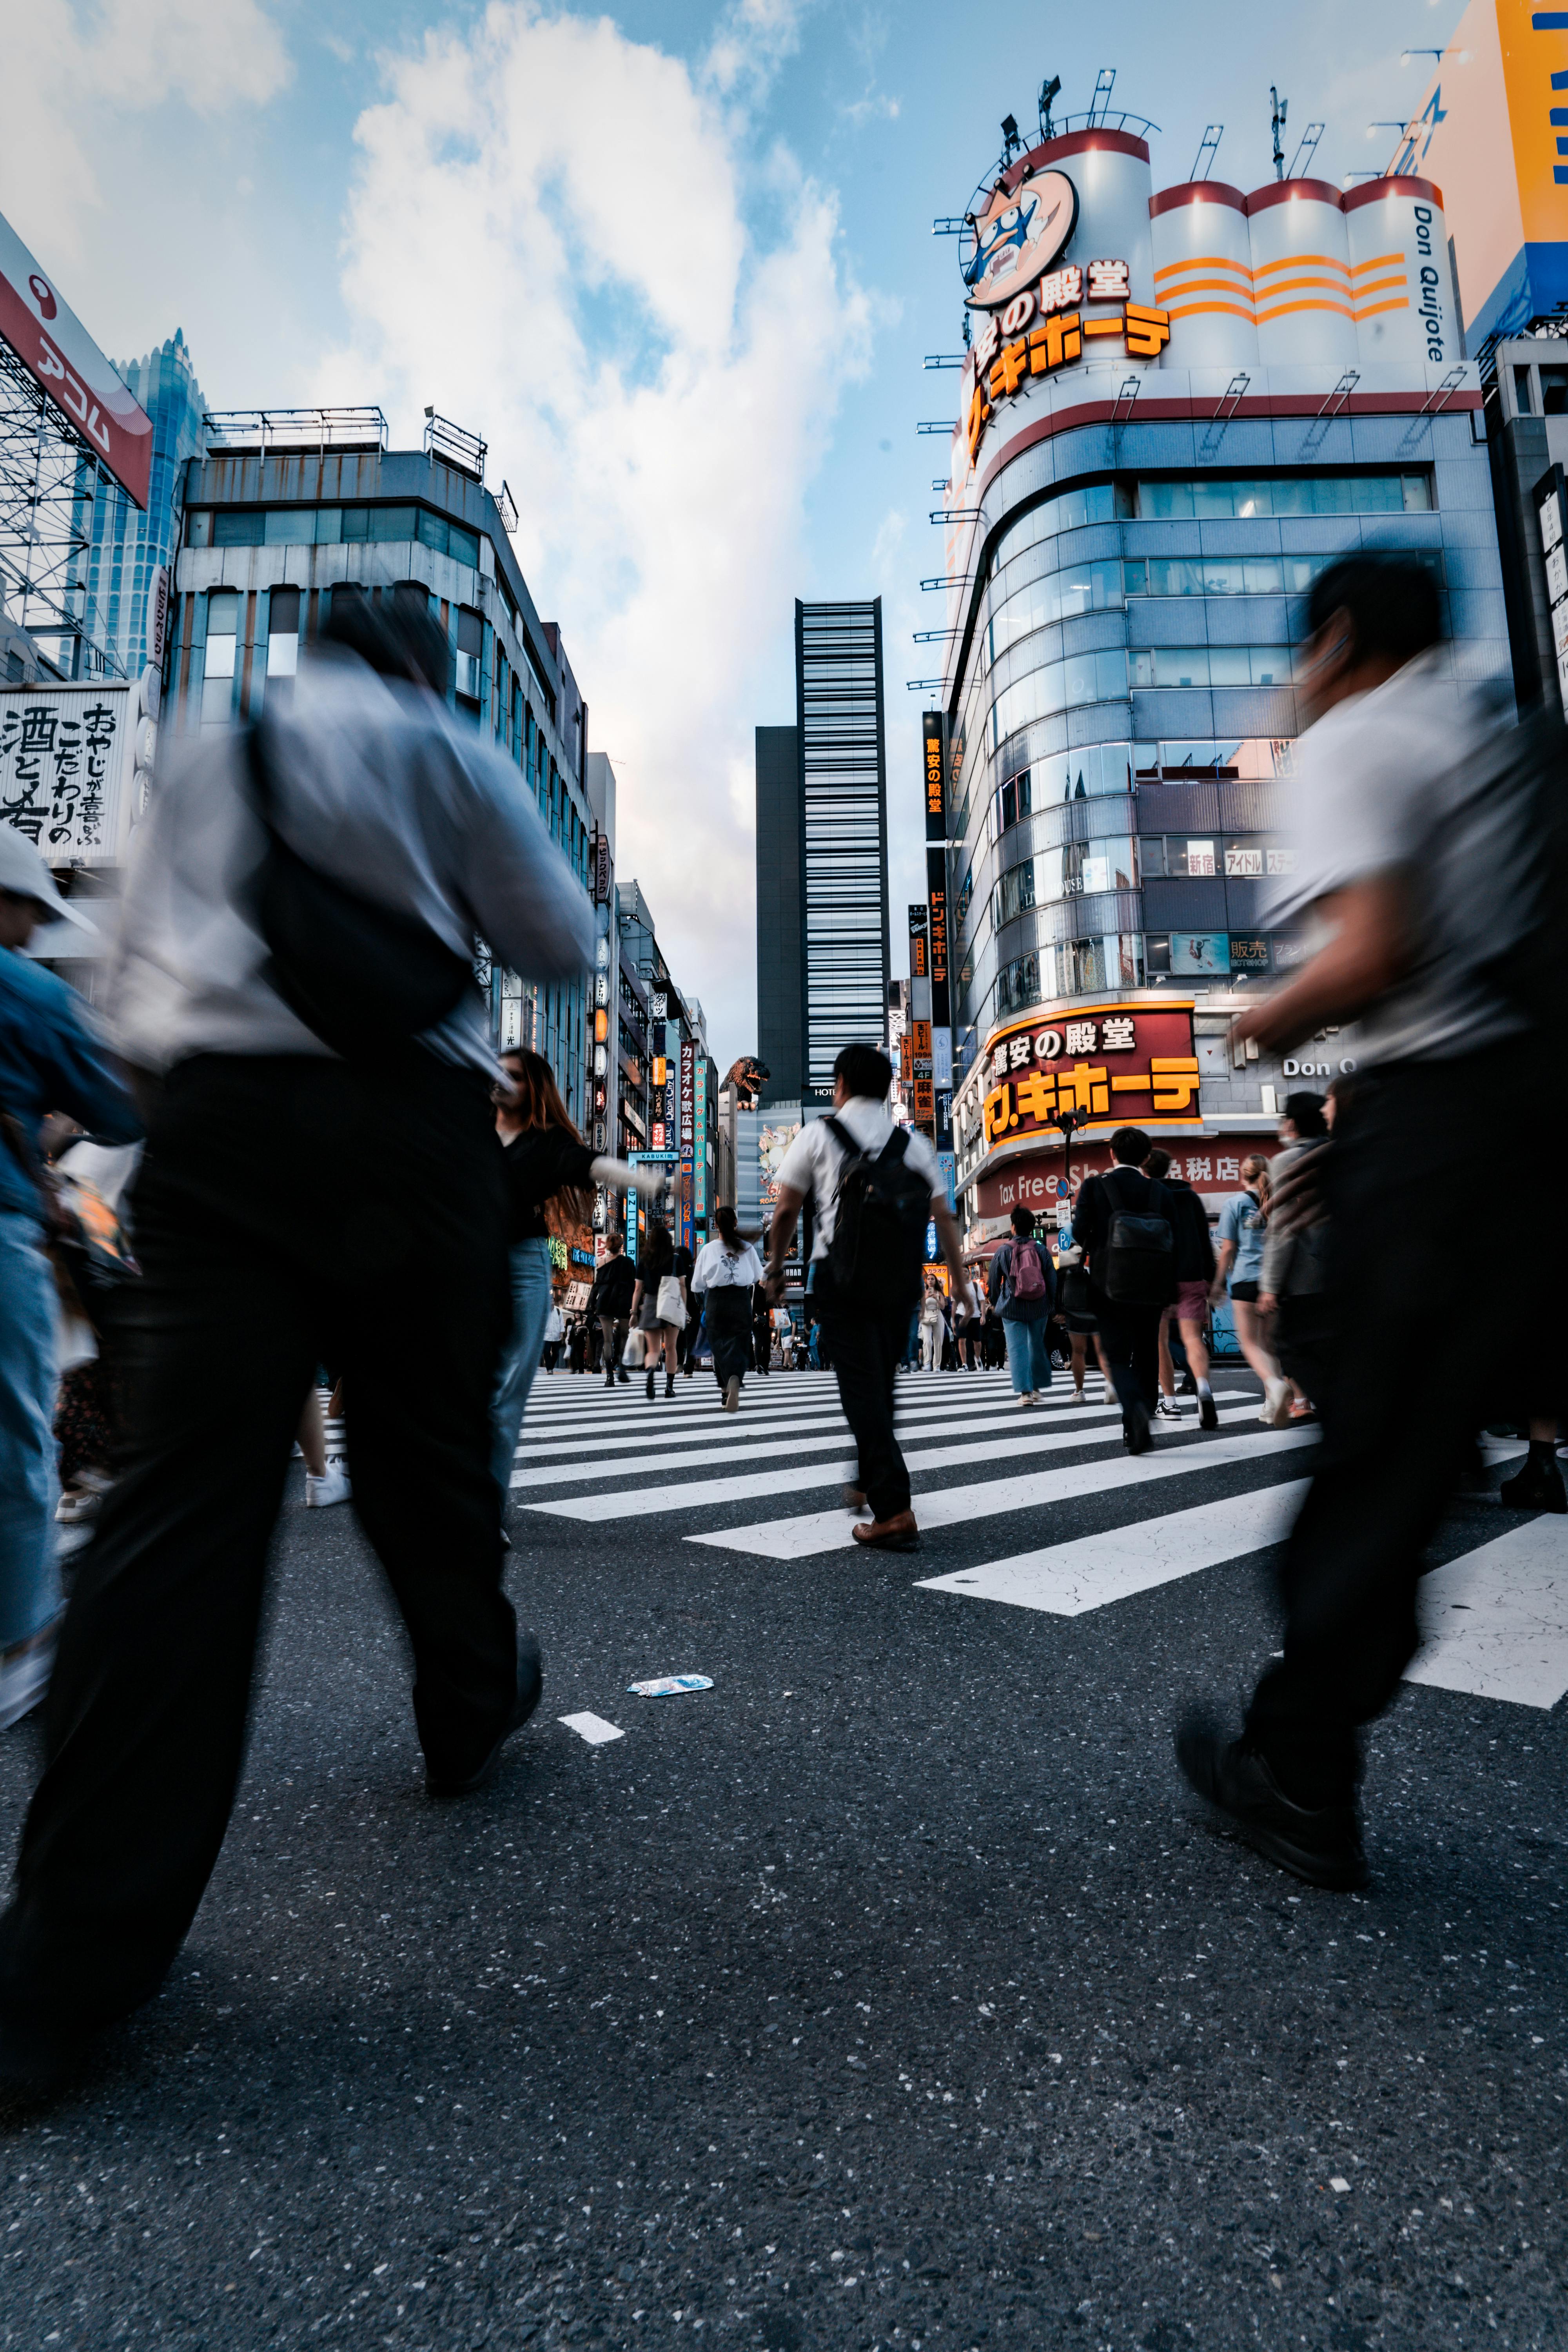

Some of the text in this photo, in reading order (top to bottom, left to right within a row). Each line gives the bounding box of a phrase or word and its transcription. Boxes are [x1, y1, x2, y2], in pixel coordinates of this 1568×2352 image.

[1414, 206, 1444, 362] Don Quijote
[49, 720, 82, 844] こだわりの
[927, 739, 942, 812] 驚安の殿堂
[1189, 854, 1214, 875] 新宿
[1227, 854, 1260, 873] アイドル
[1231, 941, 1267, 959] 販売
[994, 1017, 1136, 1078] 驚安の殿堂
[1283, 1059, 1330, 1076] Don
[681, 1046, 693, 1140] カラオケ歌広場
[917, 1081, 932, 1108] 麻雀
[999, 1183, 1015, 1207] Tax
[1018, 1175, 1058, 1200] Free
[1060, 1233, 1065, 1248] P
